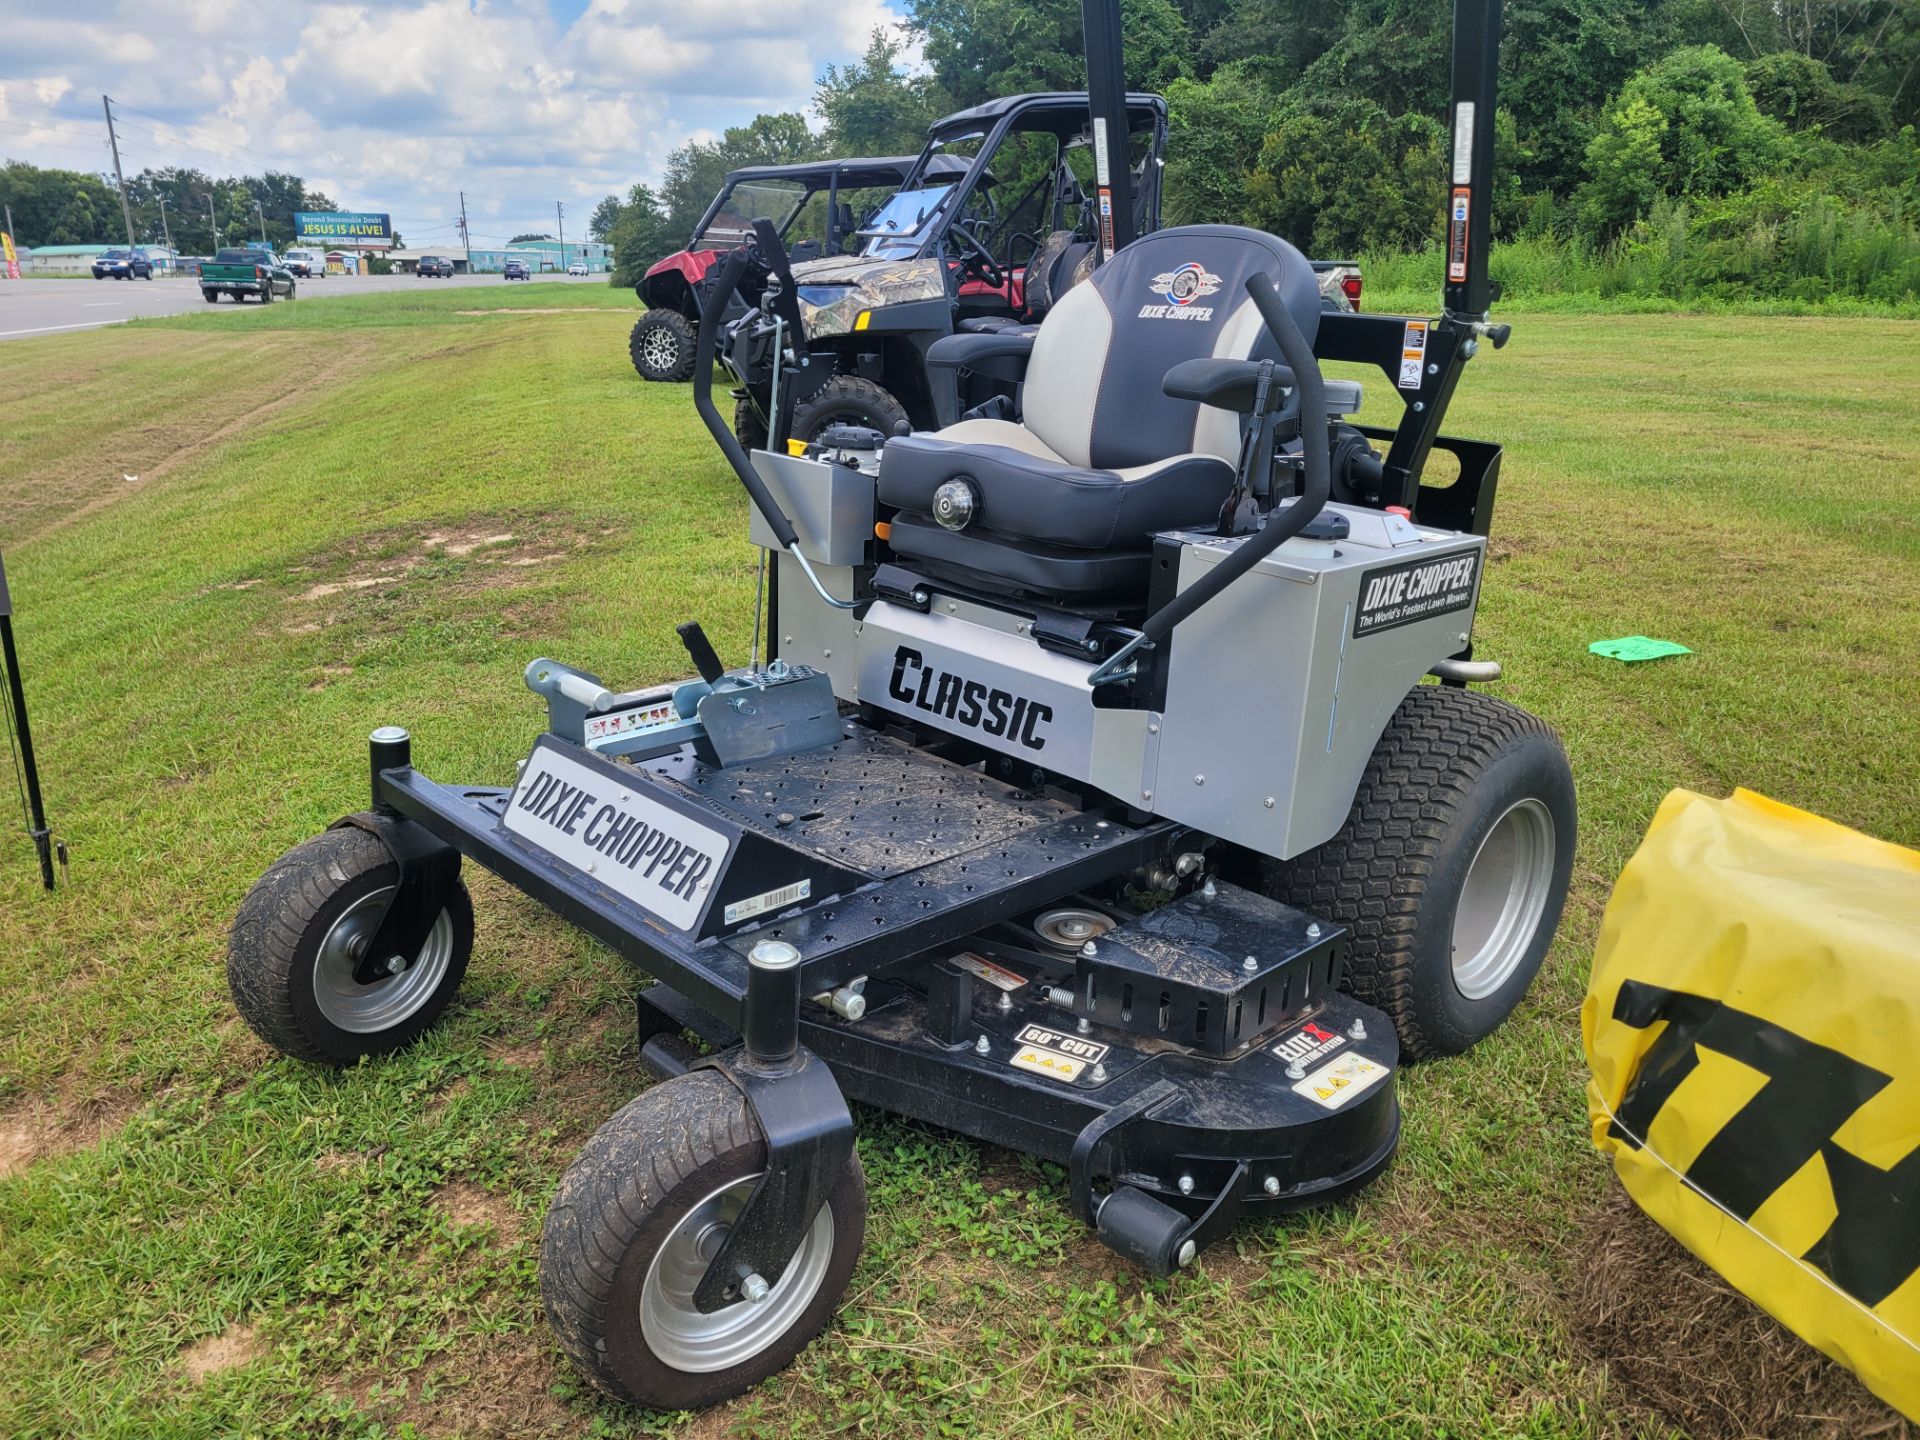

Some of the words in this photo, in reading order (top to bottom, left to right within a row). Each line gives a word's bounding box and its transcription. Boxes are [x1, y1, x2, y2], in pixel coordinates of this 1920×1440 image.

[304, 224, 334, 234] JESUS
[337, 225, 346, 234] IS
[350, 225, 383, 235] ALIVE!
[363, 216, 381, 224] Doubt
[874, 267, 936, 285] XP
[1138, 304, 1169, 318] DIXIE
[1166, 305, 1214, 321] CHOPPER
[1363, 571, 1410, 612] DIXIE
[1406, 557, 1474, 600] CHOPPER
[1360, 616, 1372, 628] The
[1374, 607, 1401, 623] World's
[1402, 601, 1428, 616] Fastest
[1428, 597, 1445, 610] Lawn
[888, 645, 1053, 751] CLASSIC
[518, 770, 597, 837] DIXIE
[583, 804, 712, 902] CHOPPER
[1025, 1029, 1062, 1044] 60"
[1059, 1039, 1100, 1058] CUT
[1317, 1035, 1347, 1054] SYSTEM
